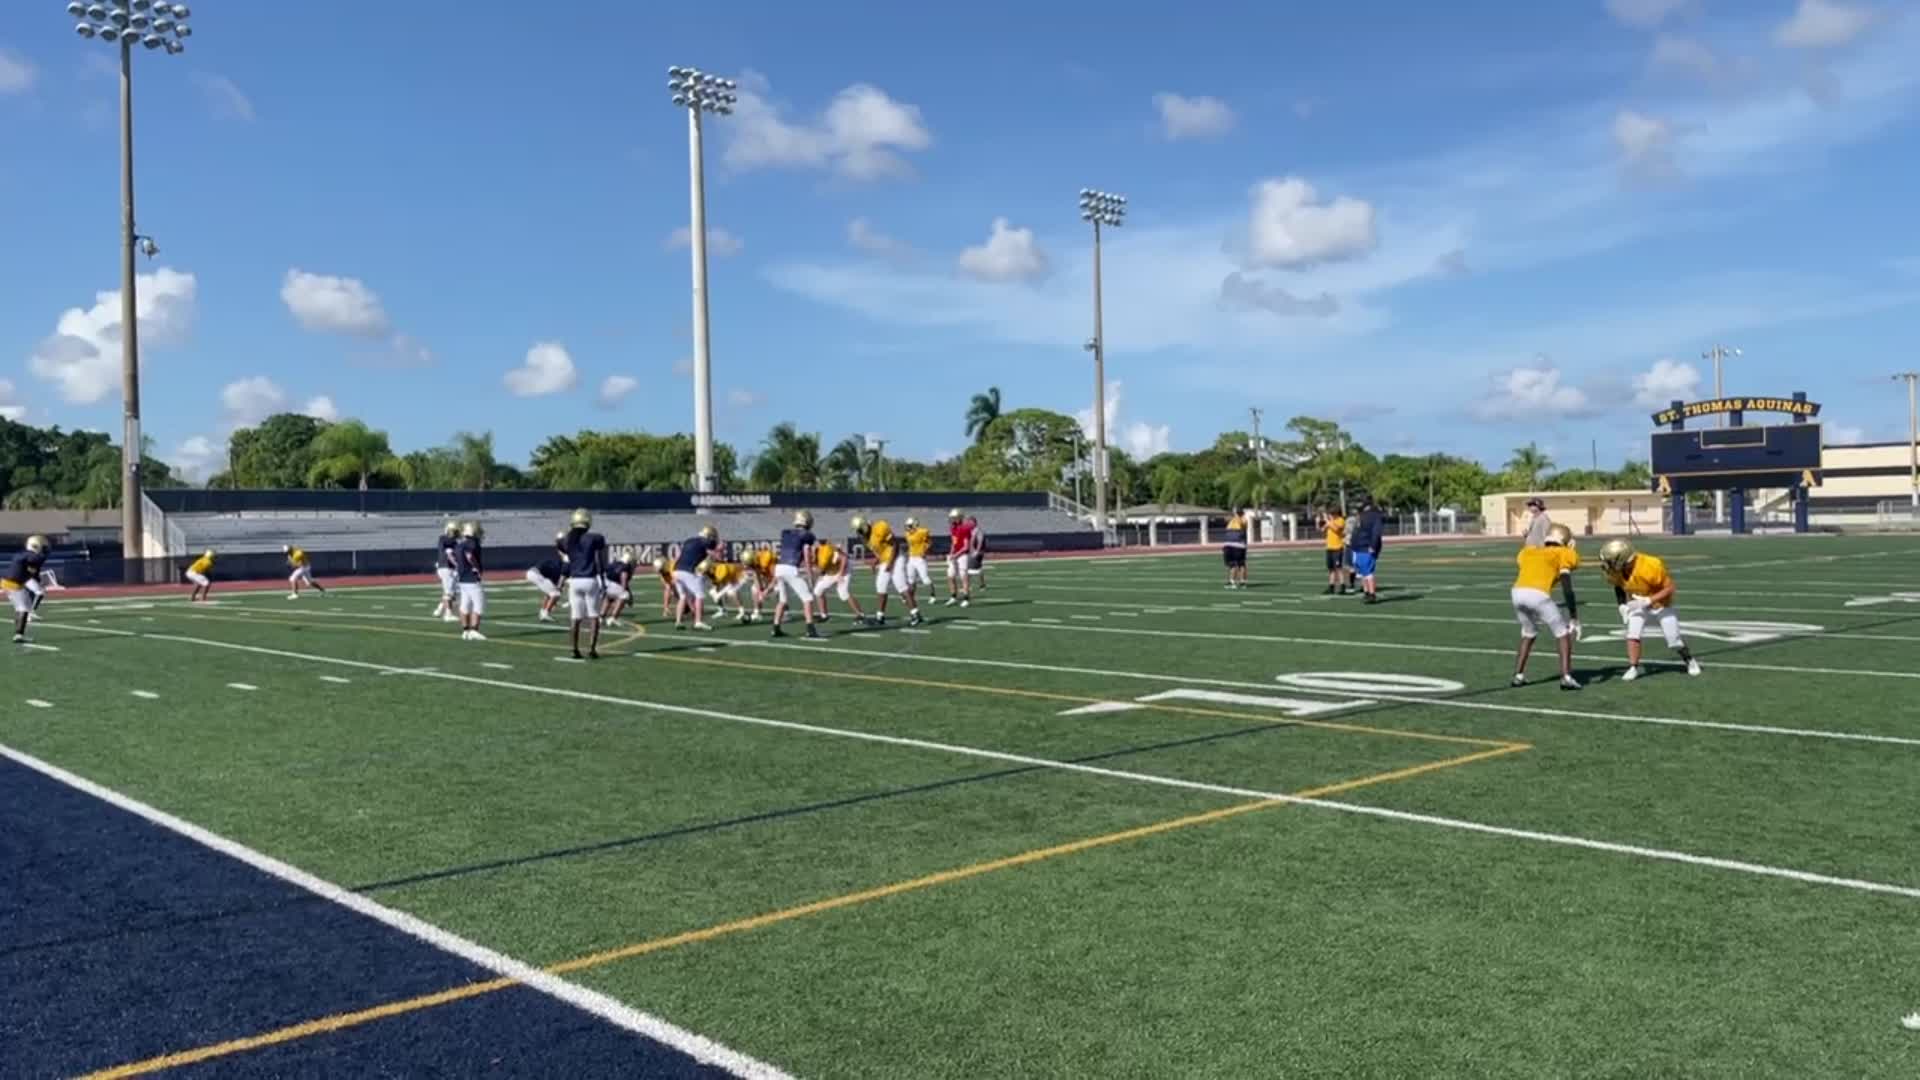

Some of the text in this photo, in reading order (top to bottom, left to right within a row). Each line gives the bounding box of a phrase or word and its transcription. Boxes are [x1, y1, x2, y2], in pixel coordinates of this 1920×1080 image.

[1683, 400, 1742, 416] THOMAS
[1747, 399, 1813, 414] AQUINAS
[1135, 672, 1464, 716] 10
